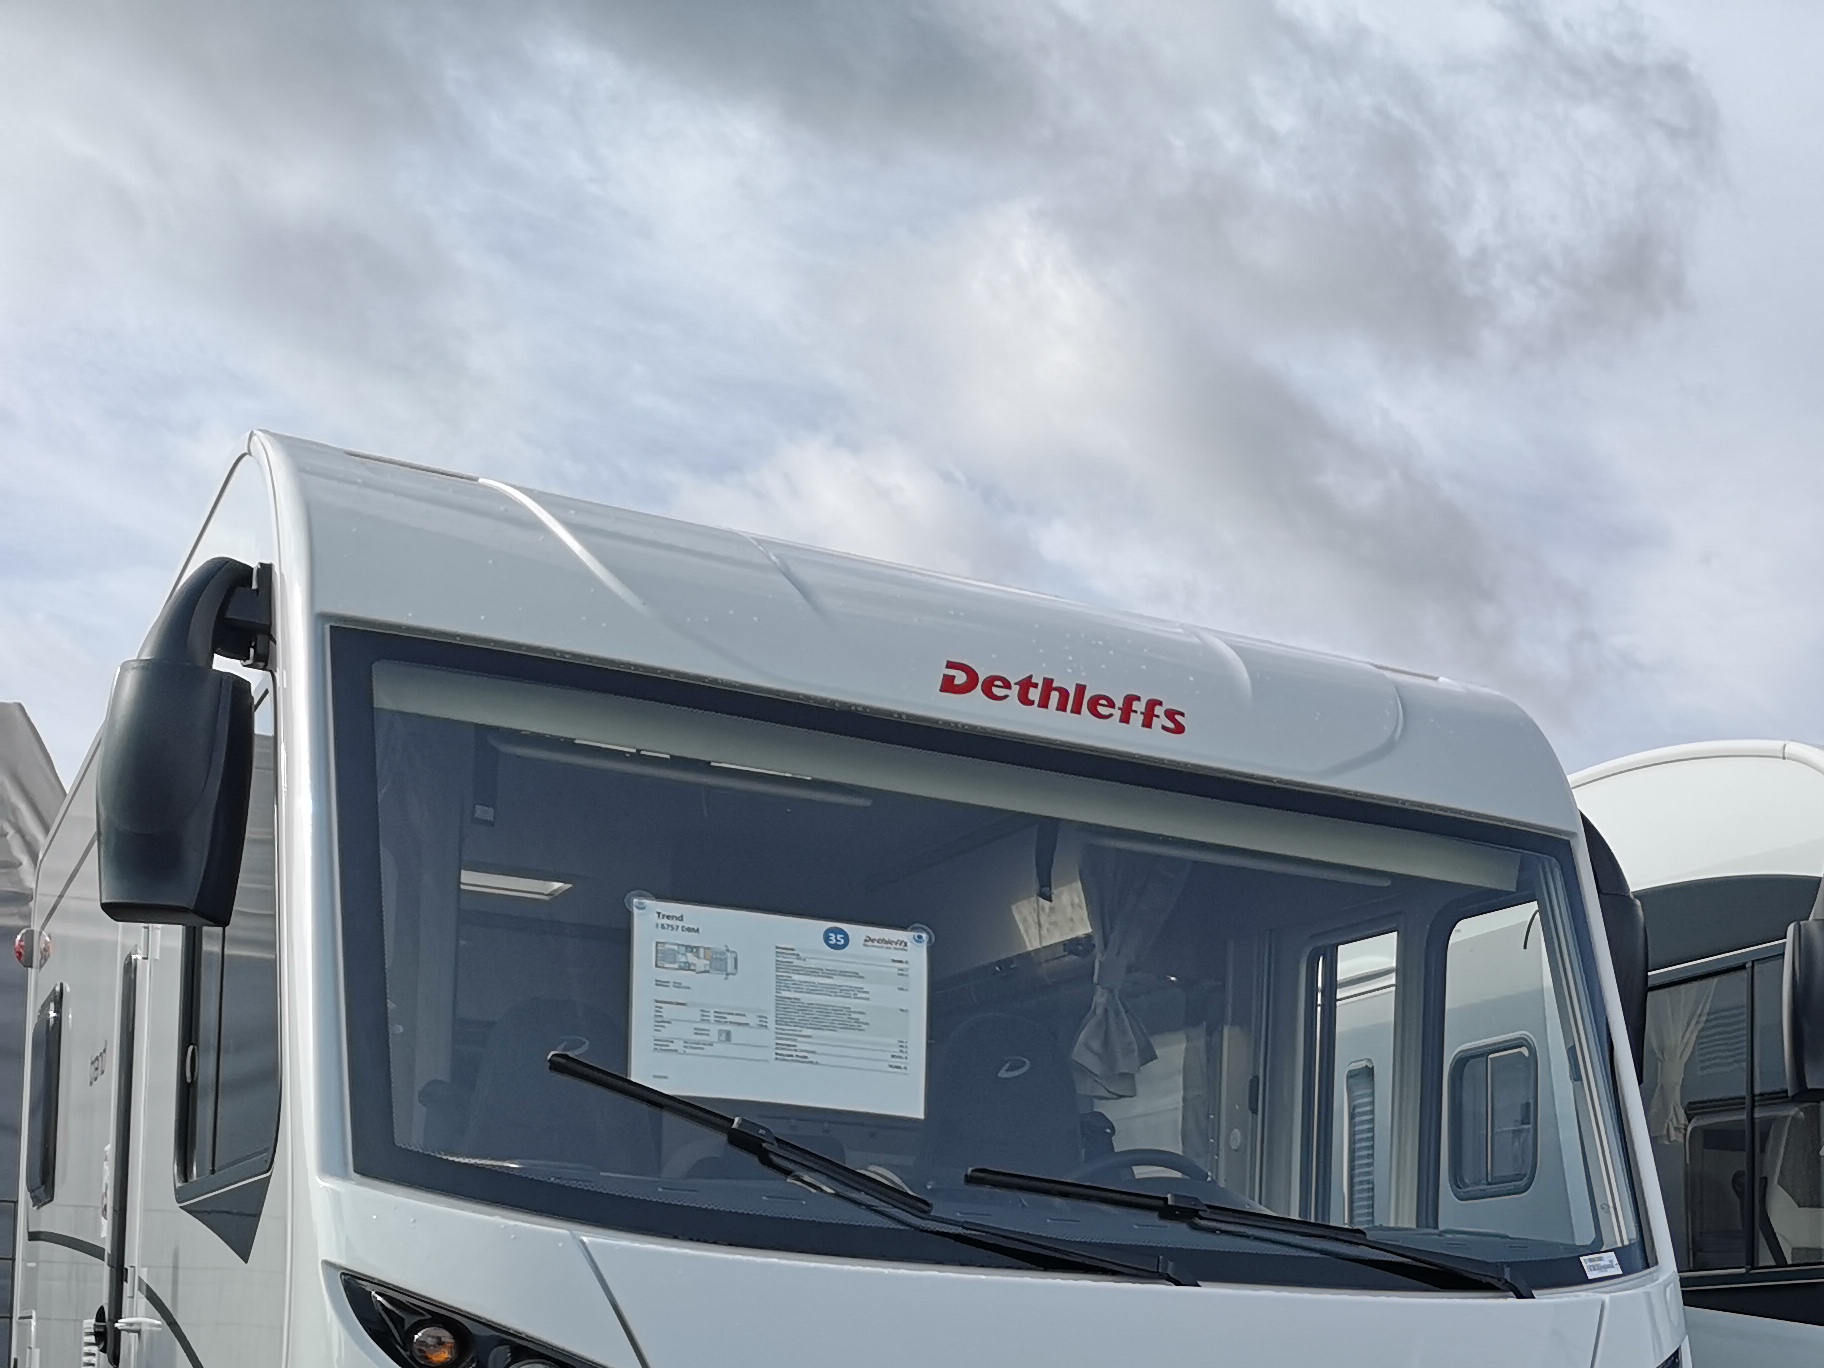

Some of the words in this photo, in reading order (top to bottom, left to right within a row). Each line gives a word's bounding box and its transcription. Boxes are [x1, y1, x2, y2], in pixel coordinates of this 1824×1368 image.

[938, 659, 1187, 736] Dethleffs
[655, 910, 684, 922] Trend
[827, 932, 846, 946] 35
